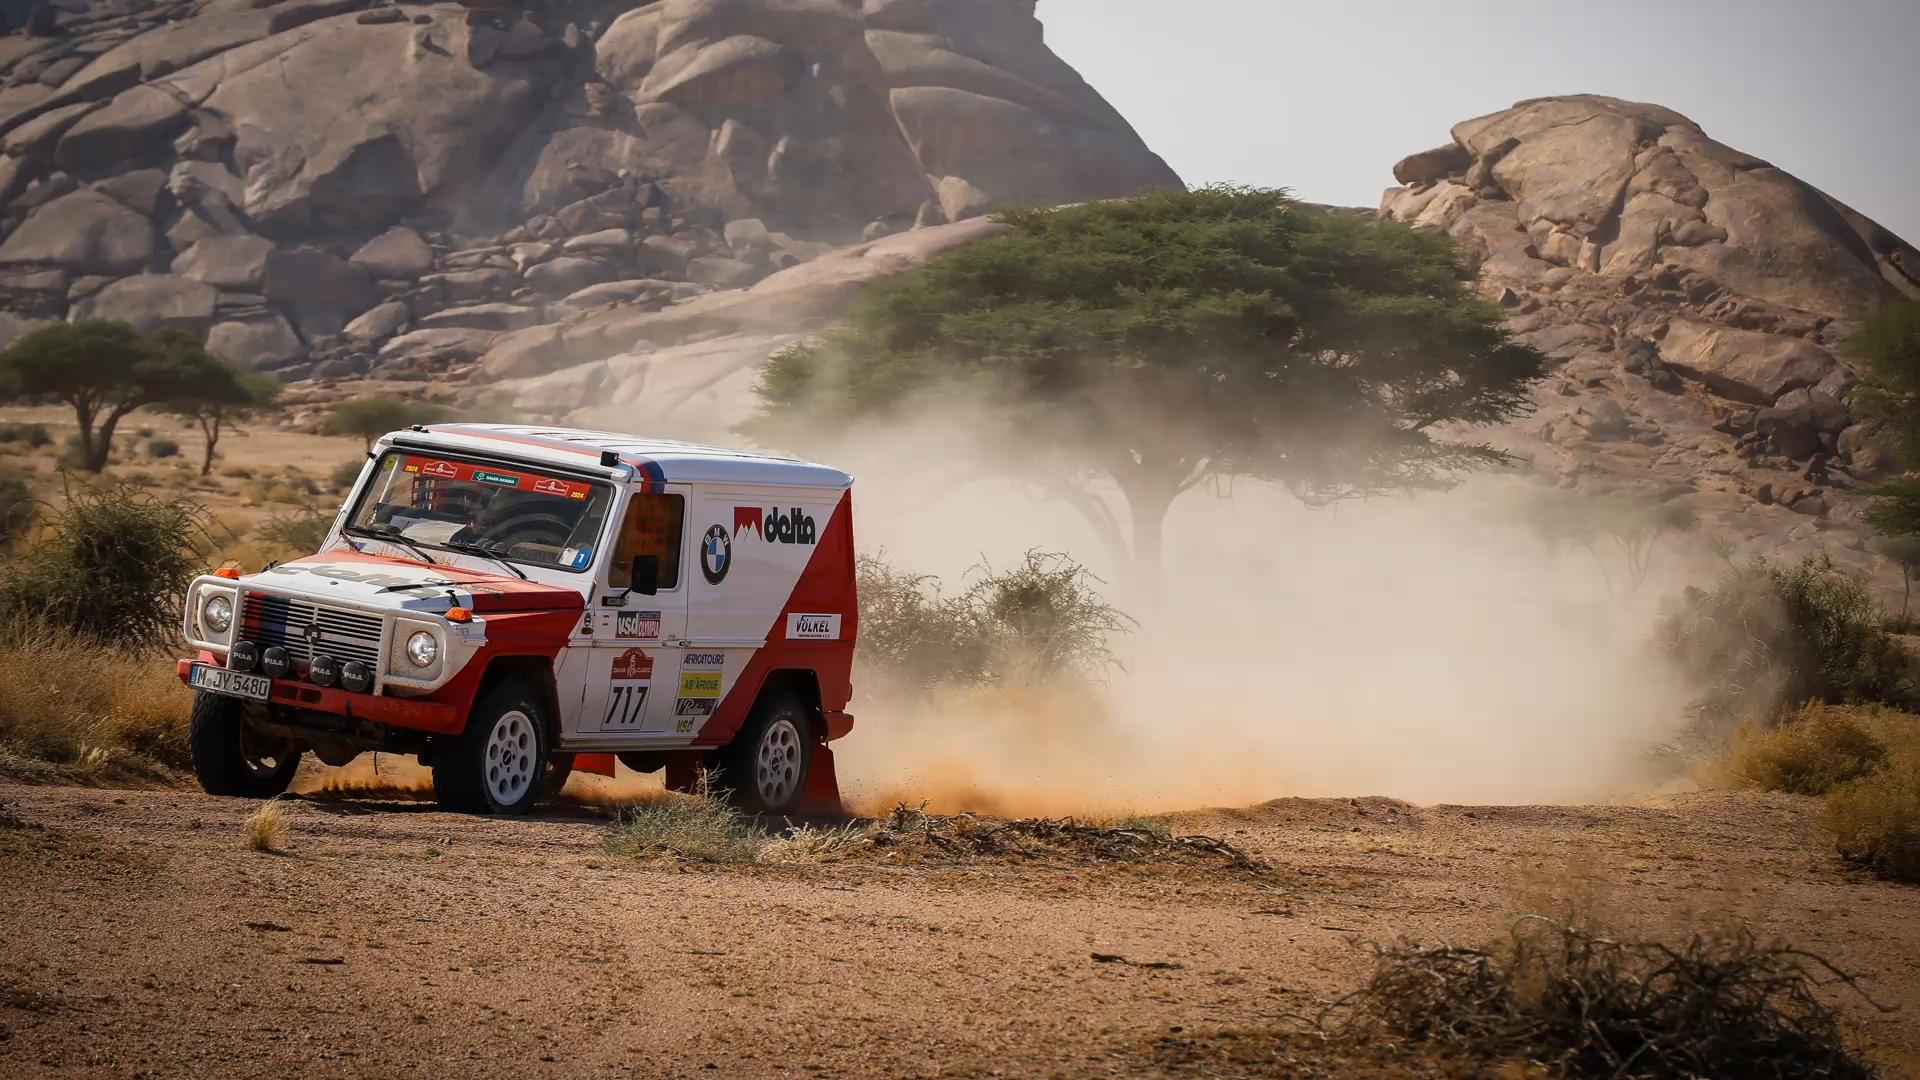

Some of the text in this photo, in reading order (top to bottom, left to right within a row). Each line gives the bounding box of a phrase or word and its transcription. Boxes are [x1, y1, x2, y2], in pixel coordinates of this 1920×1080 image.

[796, 618, 830, 632] VÖLKEL
[233, 651, 252, 661] PIAA
[683, 654, 725, 665] AFRICATOURS
[264, 657, 284, 667] PIAA
[312, 667, 331, 676] PIAA
[344, 671, 363, 681] PIAA
[196, 667, 269, 698] M JY 5480
[605, 686, 649, 724] 717
